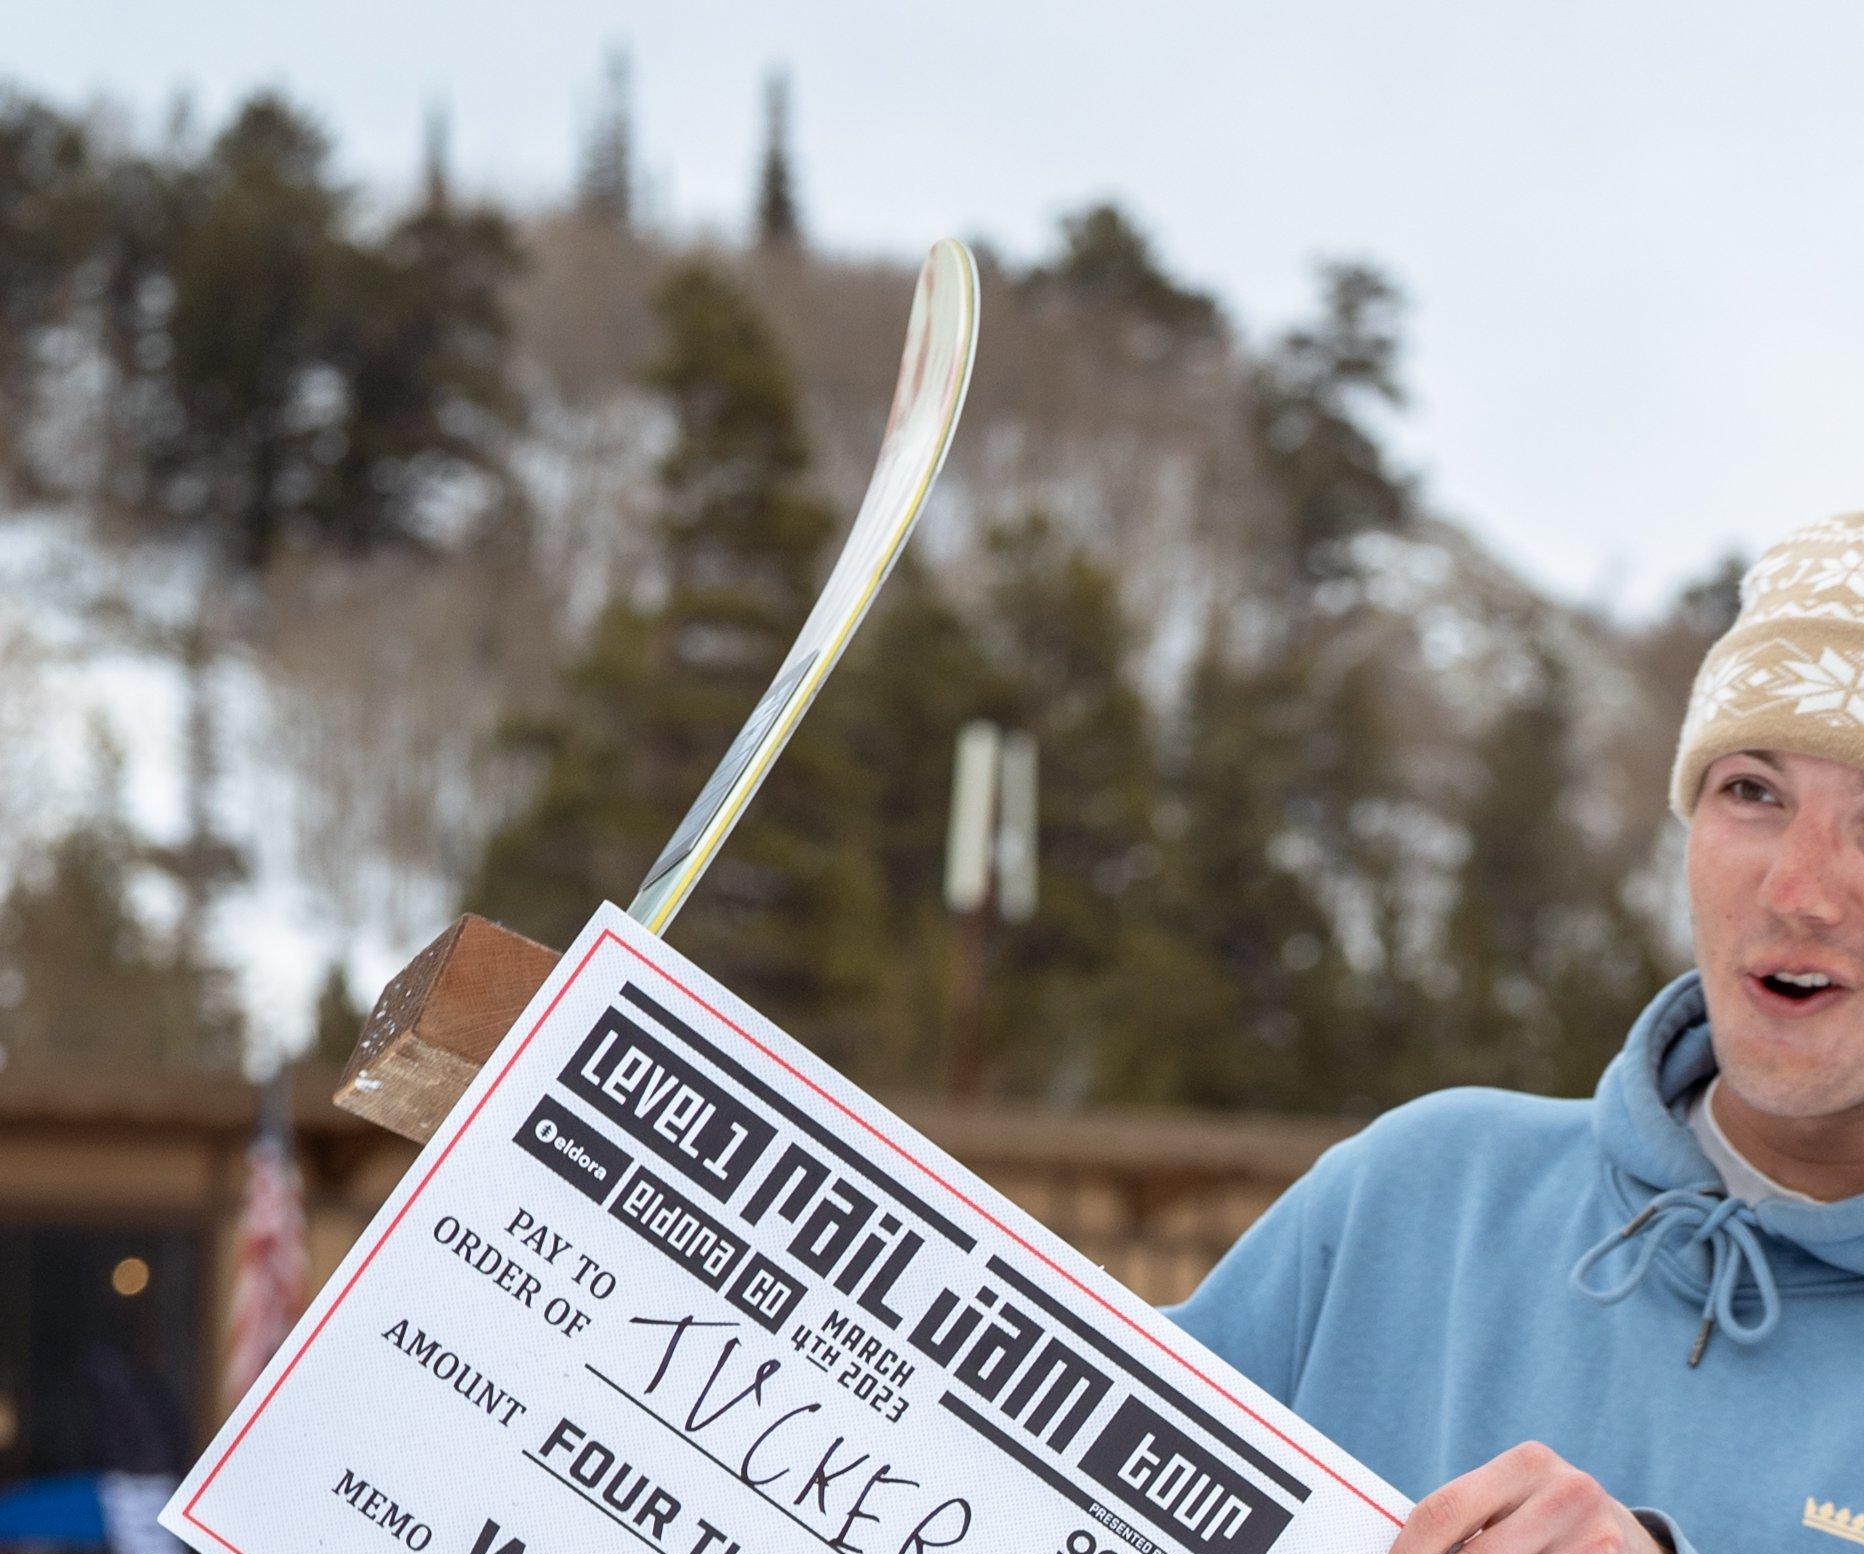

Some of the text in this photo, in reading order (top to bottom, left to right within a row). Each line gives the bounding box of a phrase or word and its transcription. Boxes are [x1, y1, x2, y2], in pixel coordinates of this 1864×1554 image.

[554, 1137, 606, 1180] eldora
[433, 1216, 591, 1337] ORDER OF
[504, 1207, 615, 1299] PAY TO
[742, 1269, 791, 1319] CO
[381, 1319, 526, 1427] AMOUNT
[791, 1324, 909, 1423] 4TH 2023
[820, 1309, 915, 1388] MARCH
[331, 1469, 432, 1551] MEMO
[538, 1417, 681, 1541] FOUR
[1088, 1503, 1152, 1552] PRESENTED
